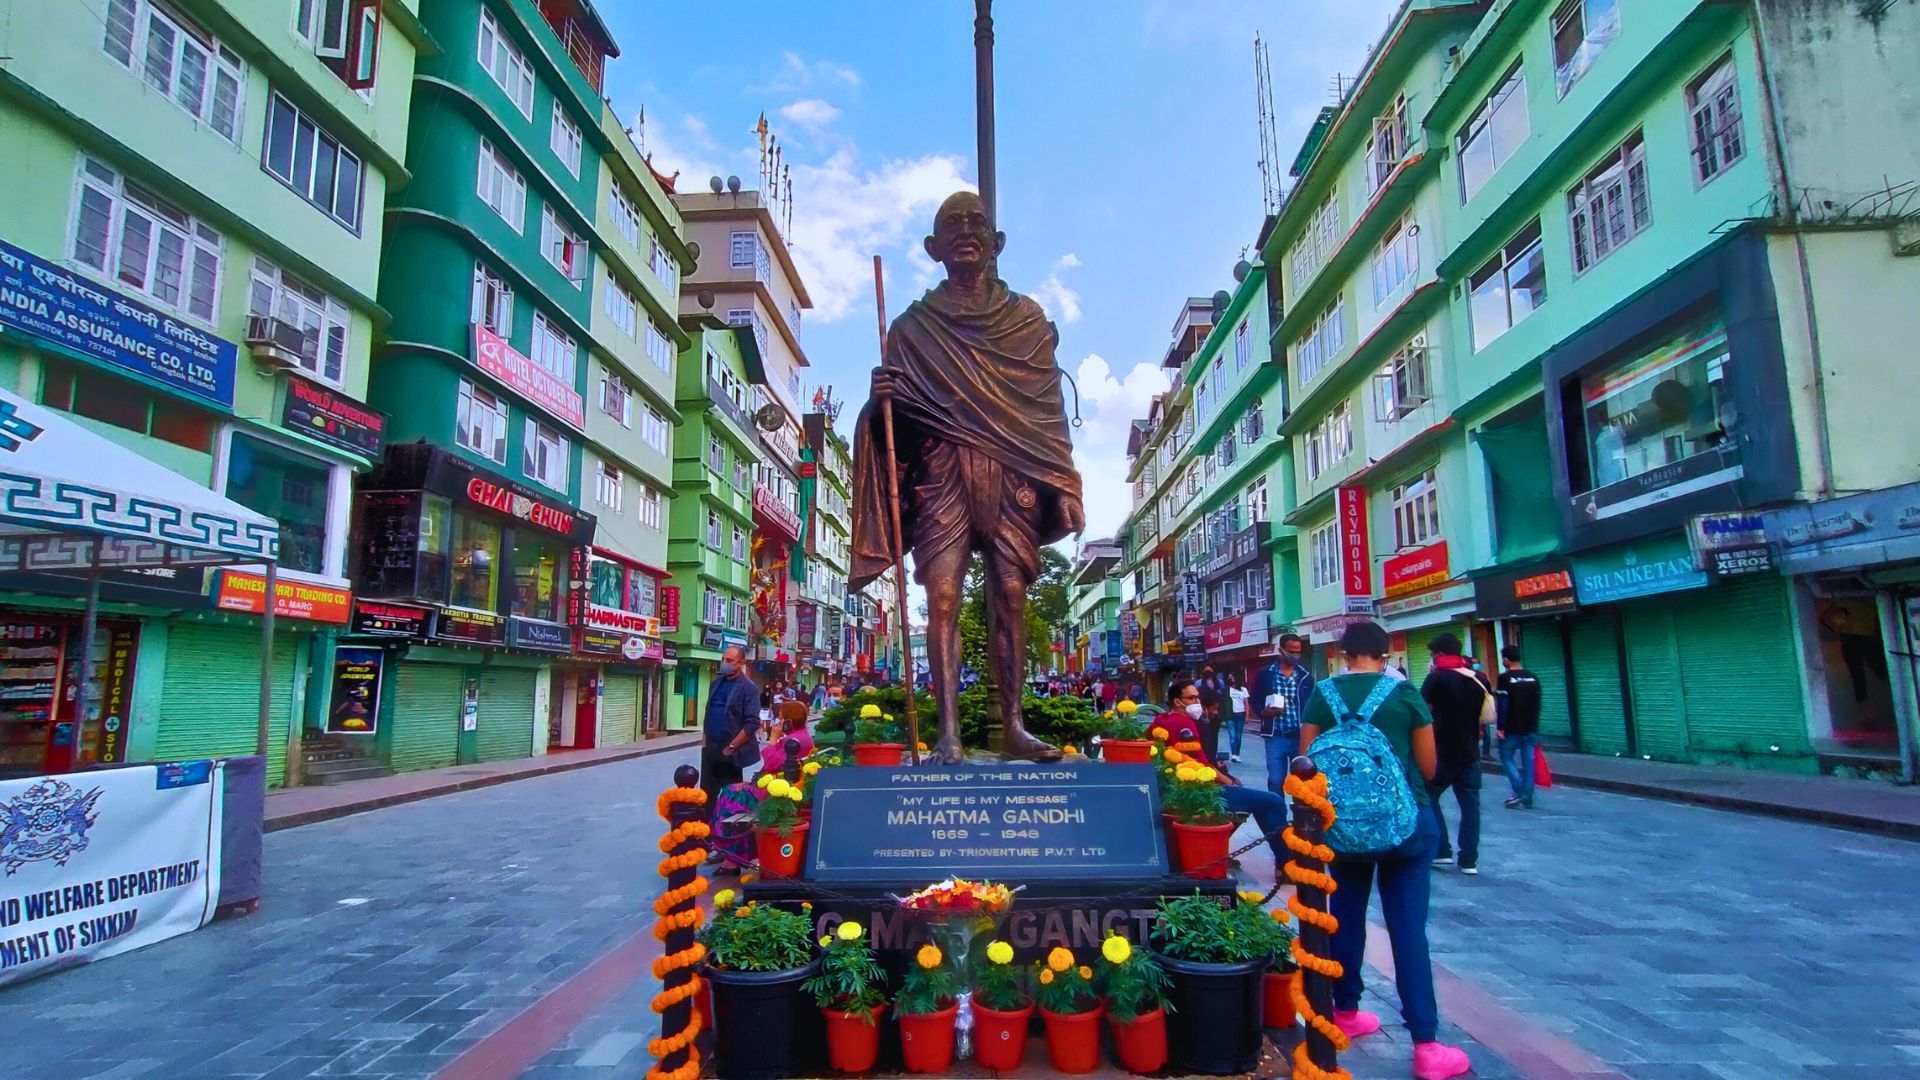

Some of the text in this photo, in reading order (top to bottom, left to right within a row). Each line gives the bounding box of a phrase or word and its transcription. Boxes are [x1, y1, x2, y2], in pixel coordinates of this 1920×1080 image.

[113, 300, 159, 328] कंपनी
[163, 319, 219, 354] लिमिटेड
[54, 310, 157, 360] ASSURANCE
[160, 352, 184, 371] CO.
[188, 363, 216, 384] LTD.
[151, 361, 216, 391] Gangtok Branch
[504, 348, 531, 383] HOTEL
[467, 478, 514, 513] CHAI
[530, 502, 573, 534] CHUN
[1348, 490, 1362, 590] Raymond
[1584, 573, 1611, 592] SRI
[1614, 556, 1693, 586] NIKETAN
[1717, 556, 1769, 569] XEROX
[228, 576, 347, 605] MAHESARI TRADING CO.
[279, 599, 313, 611] G. MARG
[110, 650, 127, 714] MEDICAL
[891, 771, 1078, 782] FATHER OF THE NATION
[887, 808, 1085, 826] MAHATMA GANDHI
[930, 796, 960, 805] LIFE
[965, 795, 976, 805] IS
[980, 795, 1000, 805] MY
[931, 829, 968, 840] 1869
[1001, 829, 1040, 840] 1948
[873, 848, 935, 858] PRESENTED
[1082, 847, 1106, 856] LTD
[25, 880, 104, 921] WELFARE
[108, 859, 200, 903] DEPARTMENT
[0, 931, 49, 969] MENT
[54, 924, 76, 953] OF
[1011, 909, 1168, 950] GANGT
